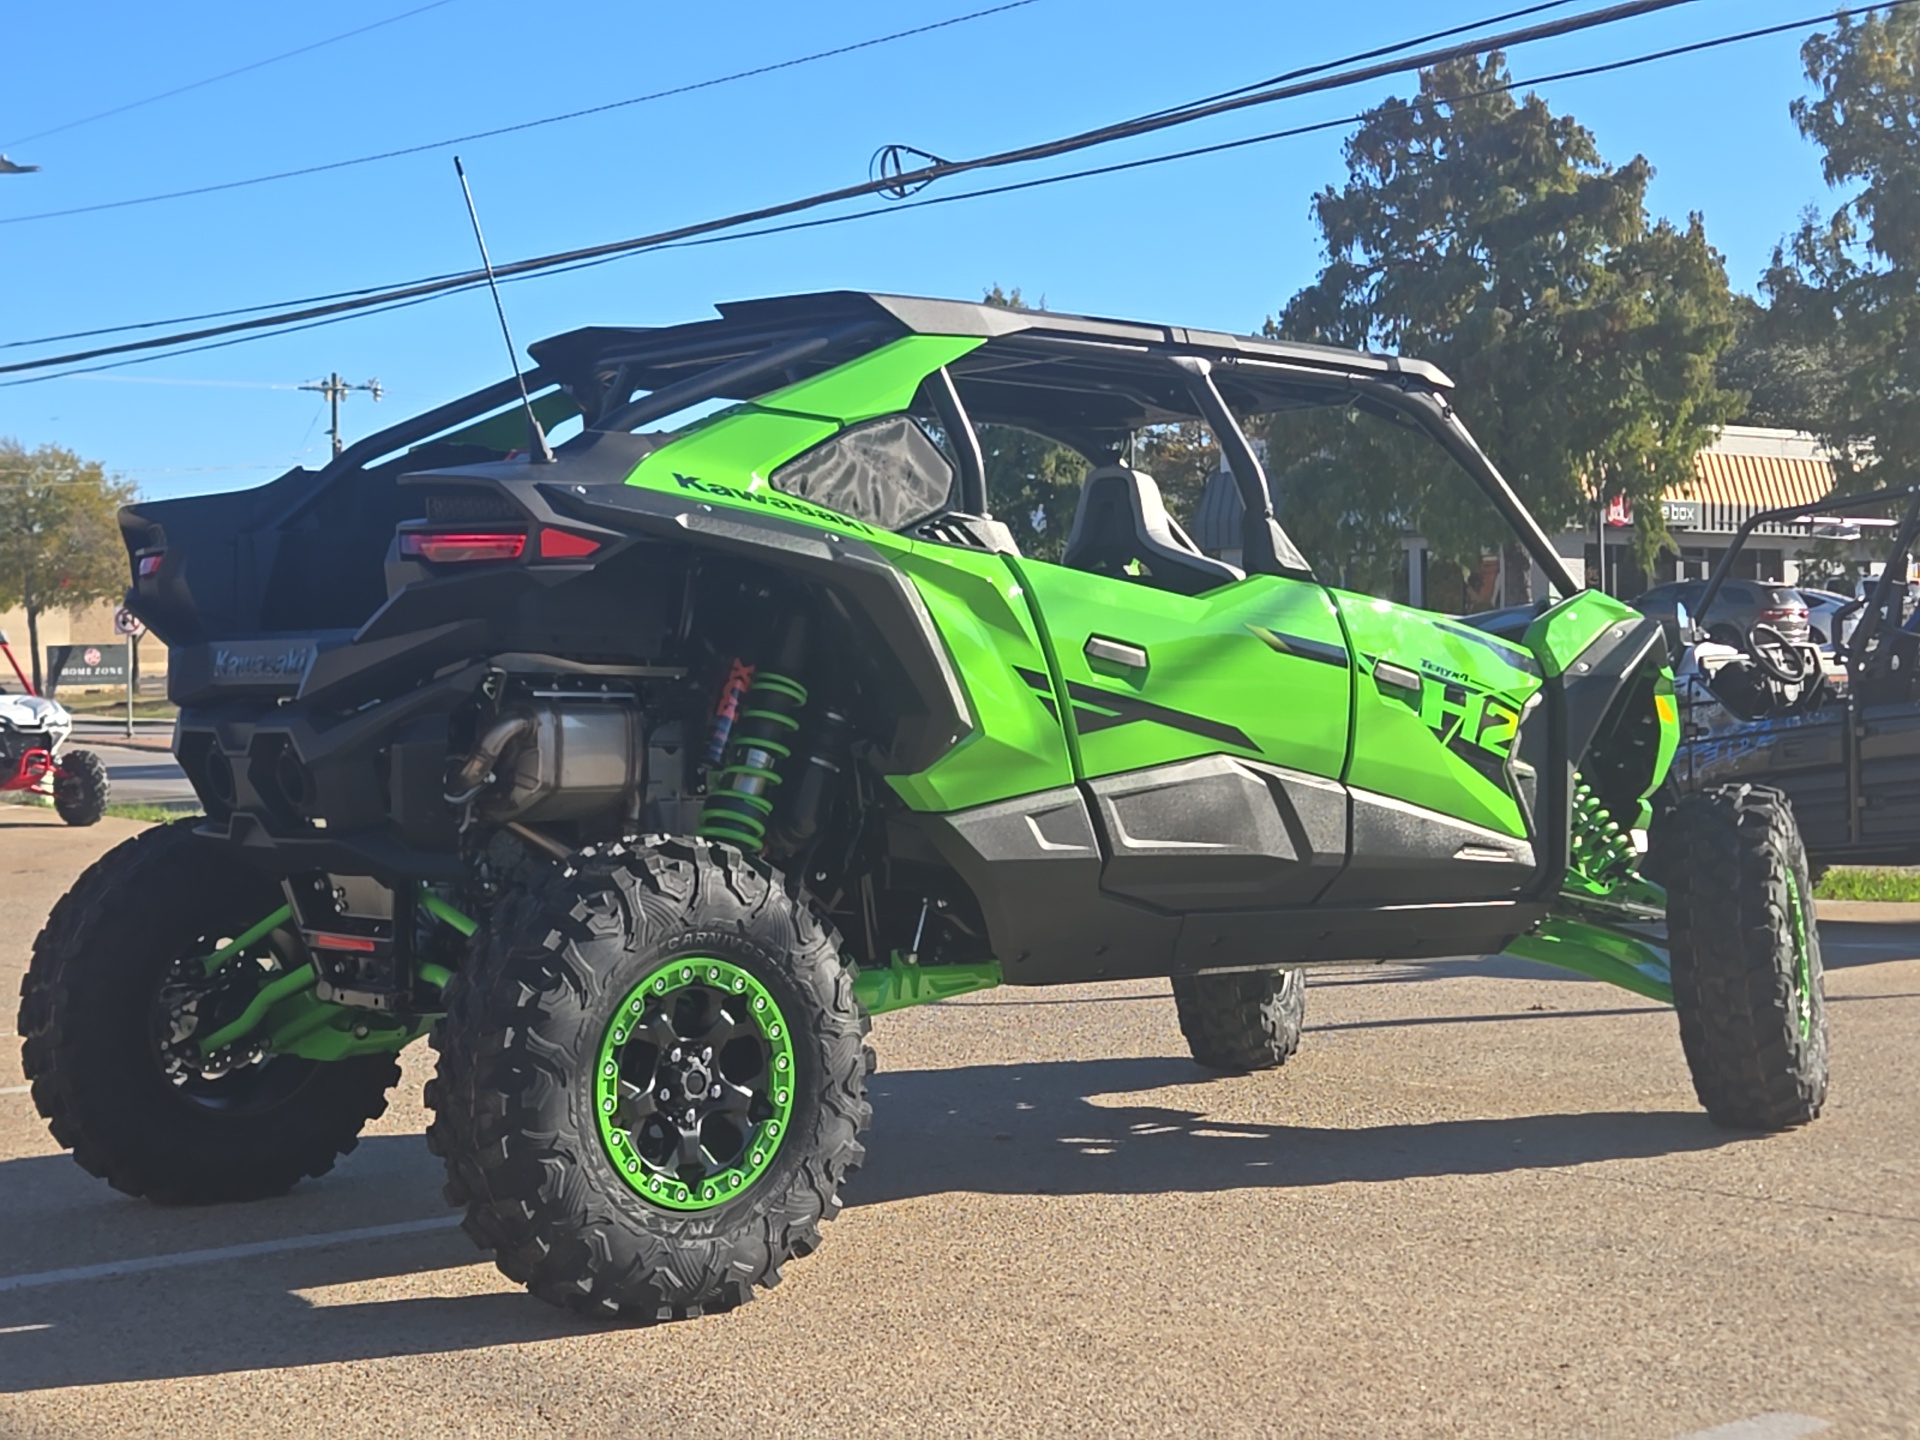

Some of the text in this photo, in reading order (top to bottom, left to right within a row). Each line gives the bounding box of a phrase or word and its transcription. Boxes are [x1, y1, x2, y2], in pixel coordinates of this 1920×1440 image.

[673, 472, 875, 536] Kawasaki
[1671, 504, 1695, 520] box
[61, 667, 92, 676] HOME
[214, 648, 307, 677] Kawasaki
[1421, 678, 1519, 759] H2
